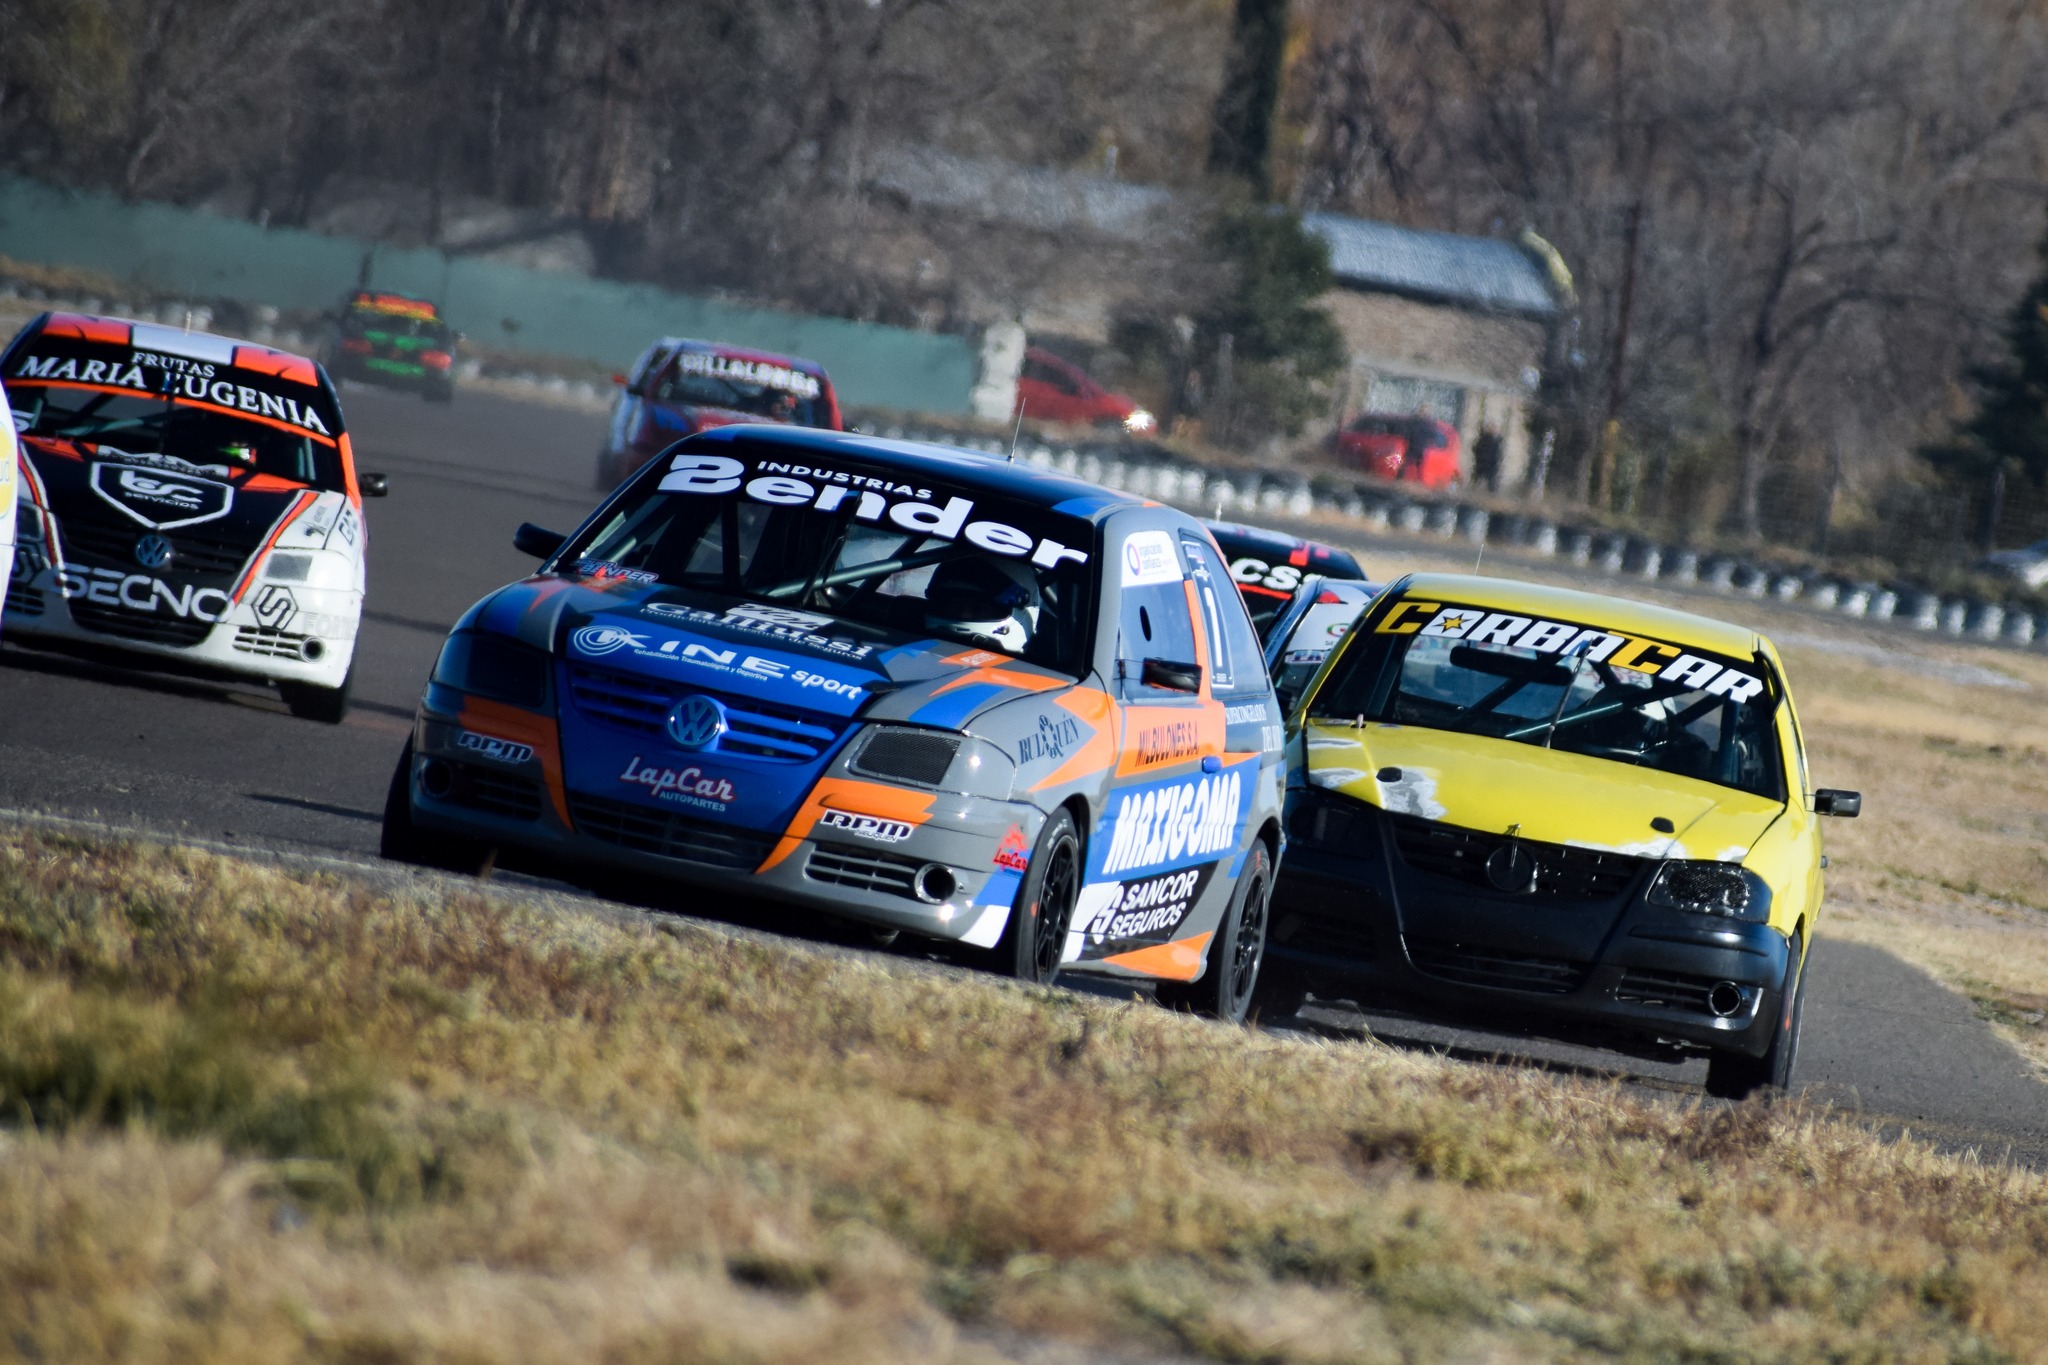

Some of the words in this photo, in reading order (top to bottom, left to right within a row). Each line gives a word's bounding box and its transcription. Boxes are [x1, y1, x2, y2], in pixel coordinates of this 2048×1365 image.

[131, 351, 216, 379] FRUTAS
[16, 355, 147, 389] MARIA
[161, 371, 330, 436] EUGENIA
[757, 460, 933, 500] INDUSTRIAS
[657, 454, 1089, 569] Bender
[1203, 587, 1223, 668] 1
[633, 648, 680, 662] Rehabilitación
[737, 667, 769, 682] Deportiva
[791, 670, 863, 700] sport
[620, 756, 735, 801] LapCar
[659, 790, 726, 812] AUTOPARTES
[821, 809, 913, 841] RPM
[1102, 770, 1240, 875] MAXIGOMA
[1121, 869, 1199, 913] SANCOR
[1109, 901, 1188, 941] SEGUROS
